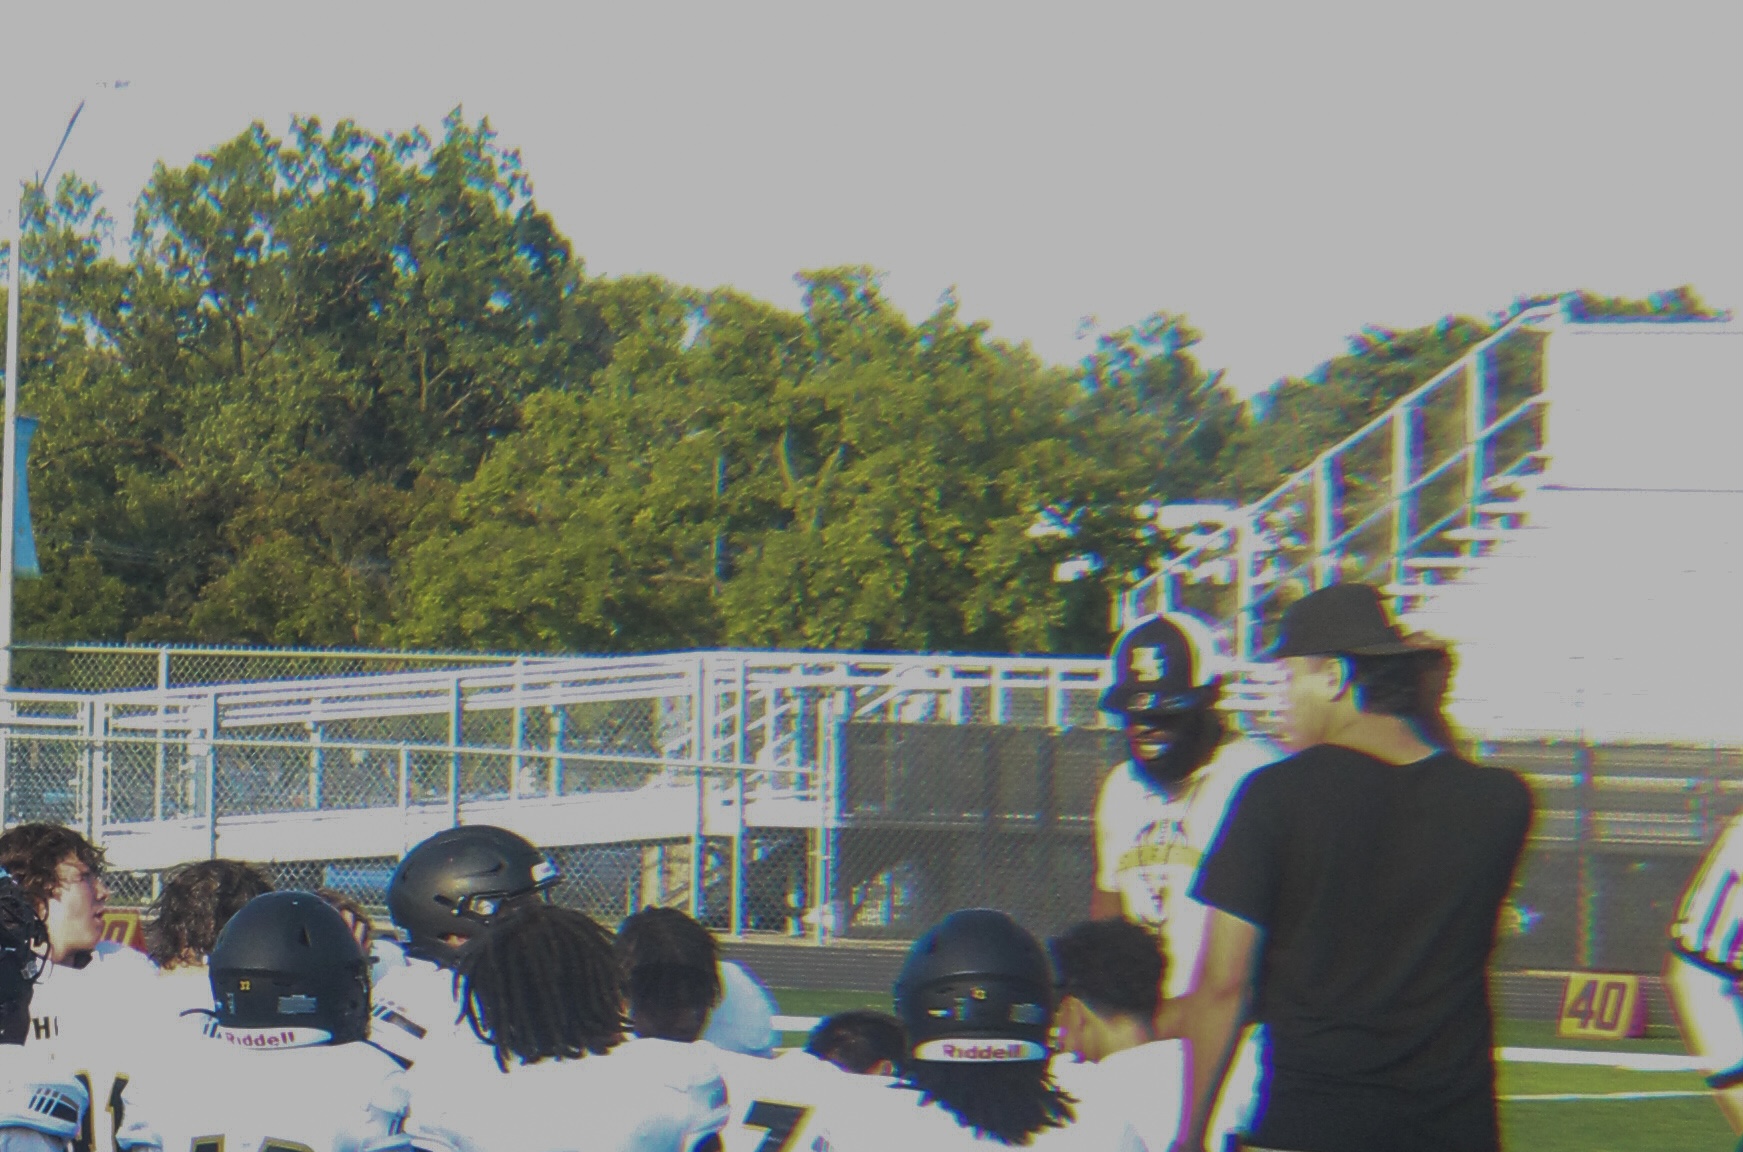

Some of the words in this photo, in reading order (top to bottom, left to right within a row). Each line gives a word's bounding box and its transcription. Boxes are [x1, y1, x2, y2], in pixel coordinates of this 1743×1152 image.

[1567, 979, 1627, 1031] 40
[224, 1031, 295, 1047] Riddell
[941, 1043, 1023, 1060] Riddell
